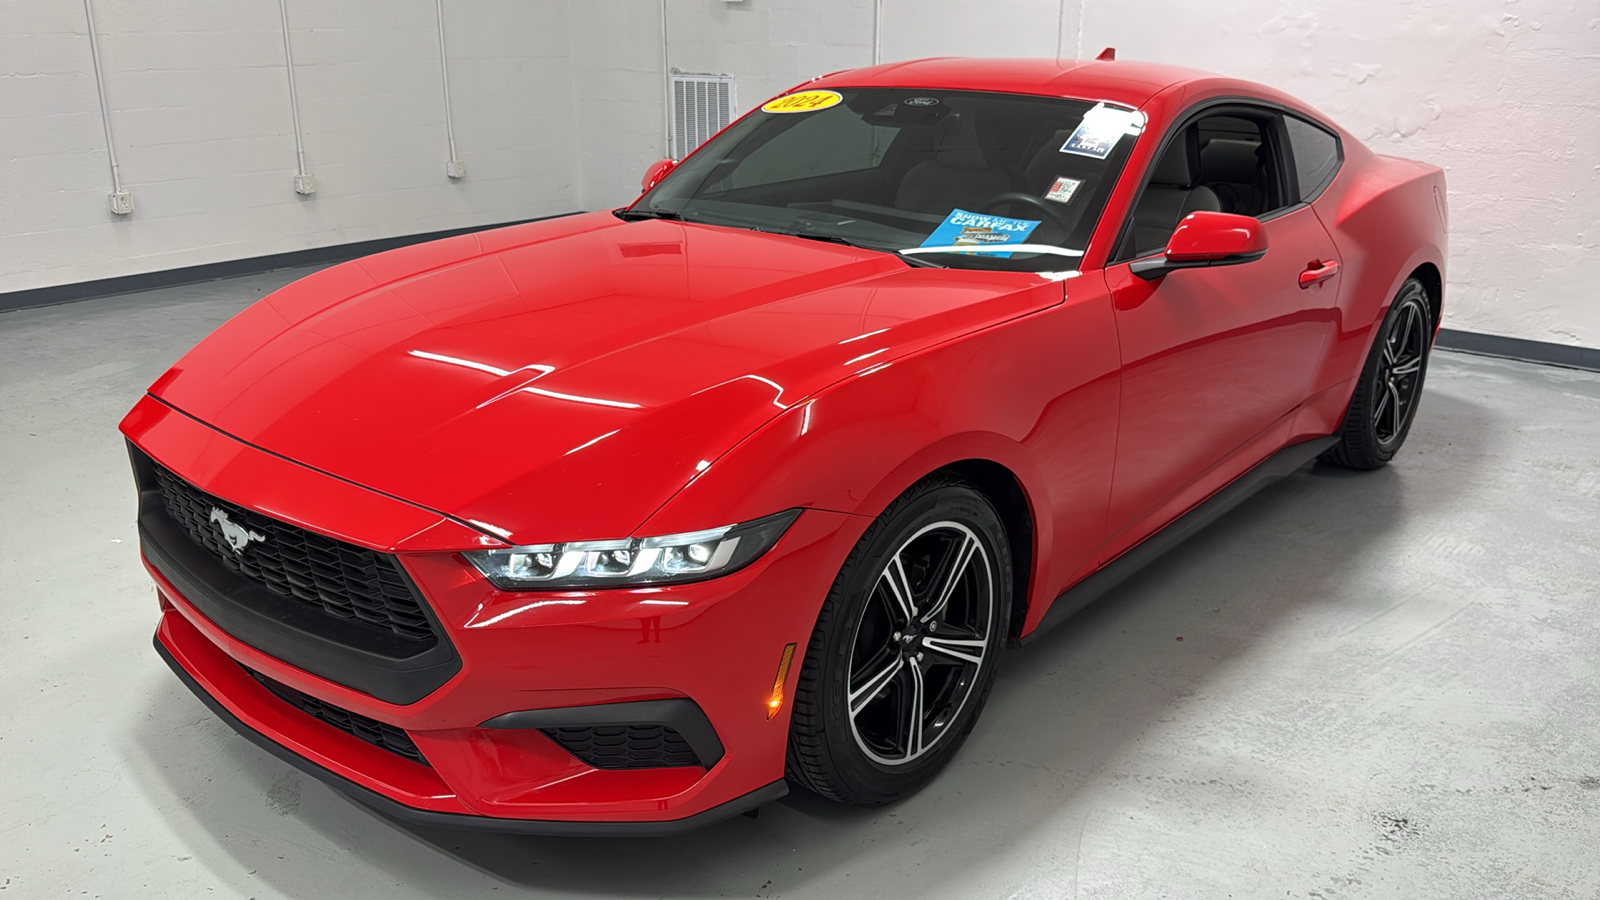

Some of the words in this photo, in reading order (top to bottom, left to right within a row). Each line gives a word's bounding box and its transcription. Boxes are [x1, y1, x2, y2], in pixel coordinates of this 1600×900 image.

[769, 95, 834, 109] 2024
[950, 217, 1028, 231] CARFAX
[955, 212, 990, 222] SHOW
